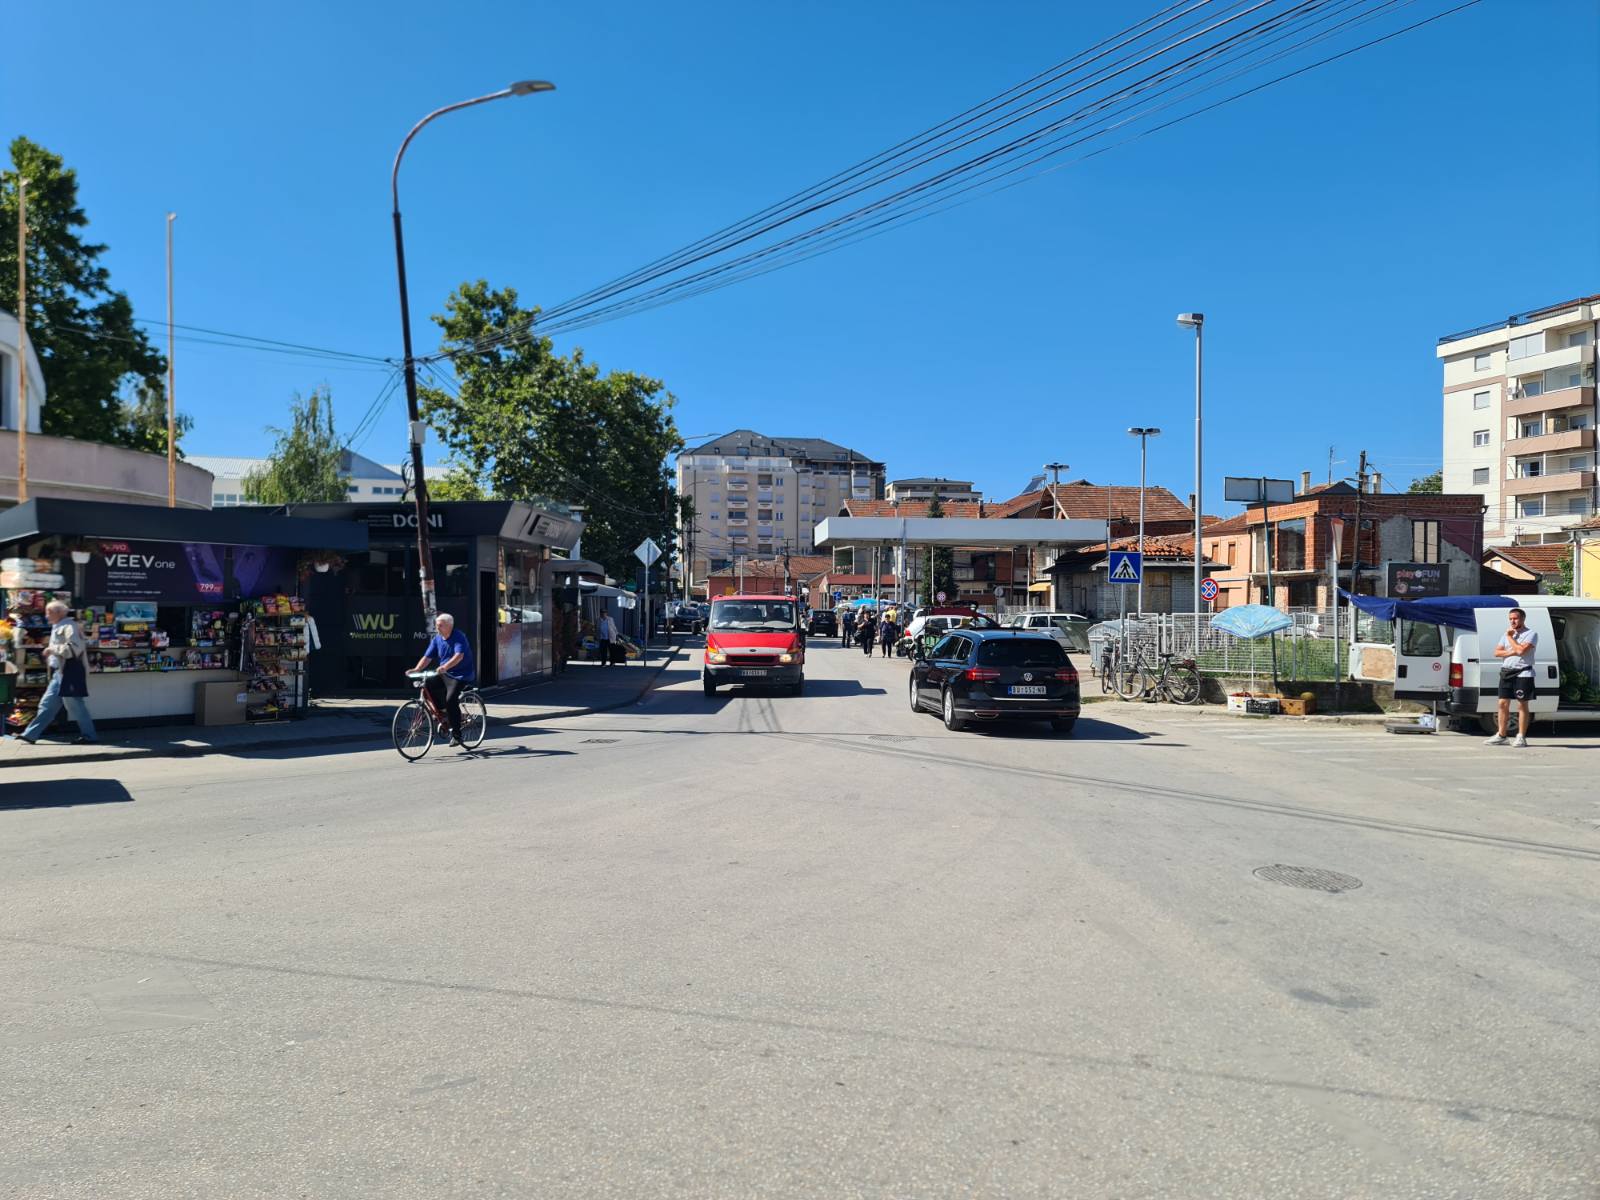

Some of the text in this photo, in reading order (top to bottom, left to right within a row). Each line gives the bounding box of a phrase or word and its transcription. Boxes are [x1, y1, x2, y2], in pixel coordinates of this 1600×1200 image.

[392, 514, 443, 528] DONI
[104, 554, 175, 569] VEEV one
[359, 614, 395, 630] WU
